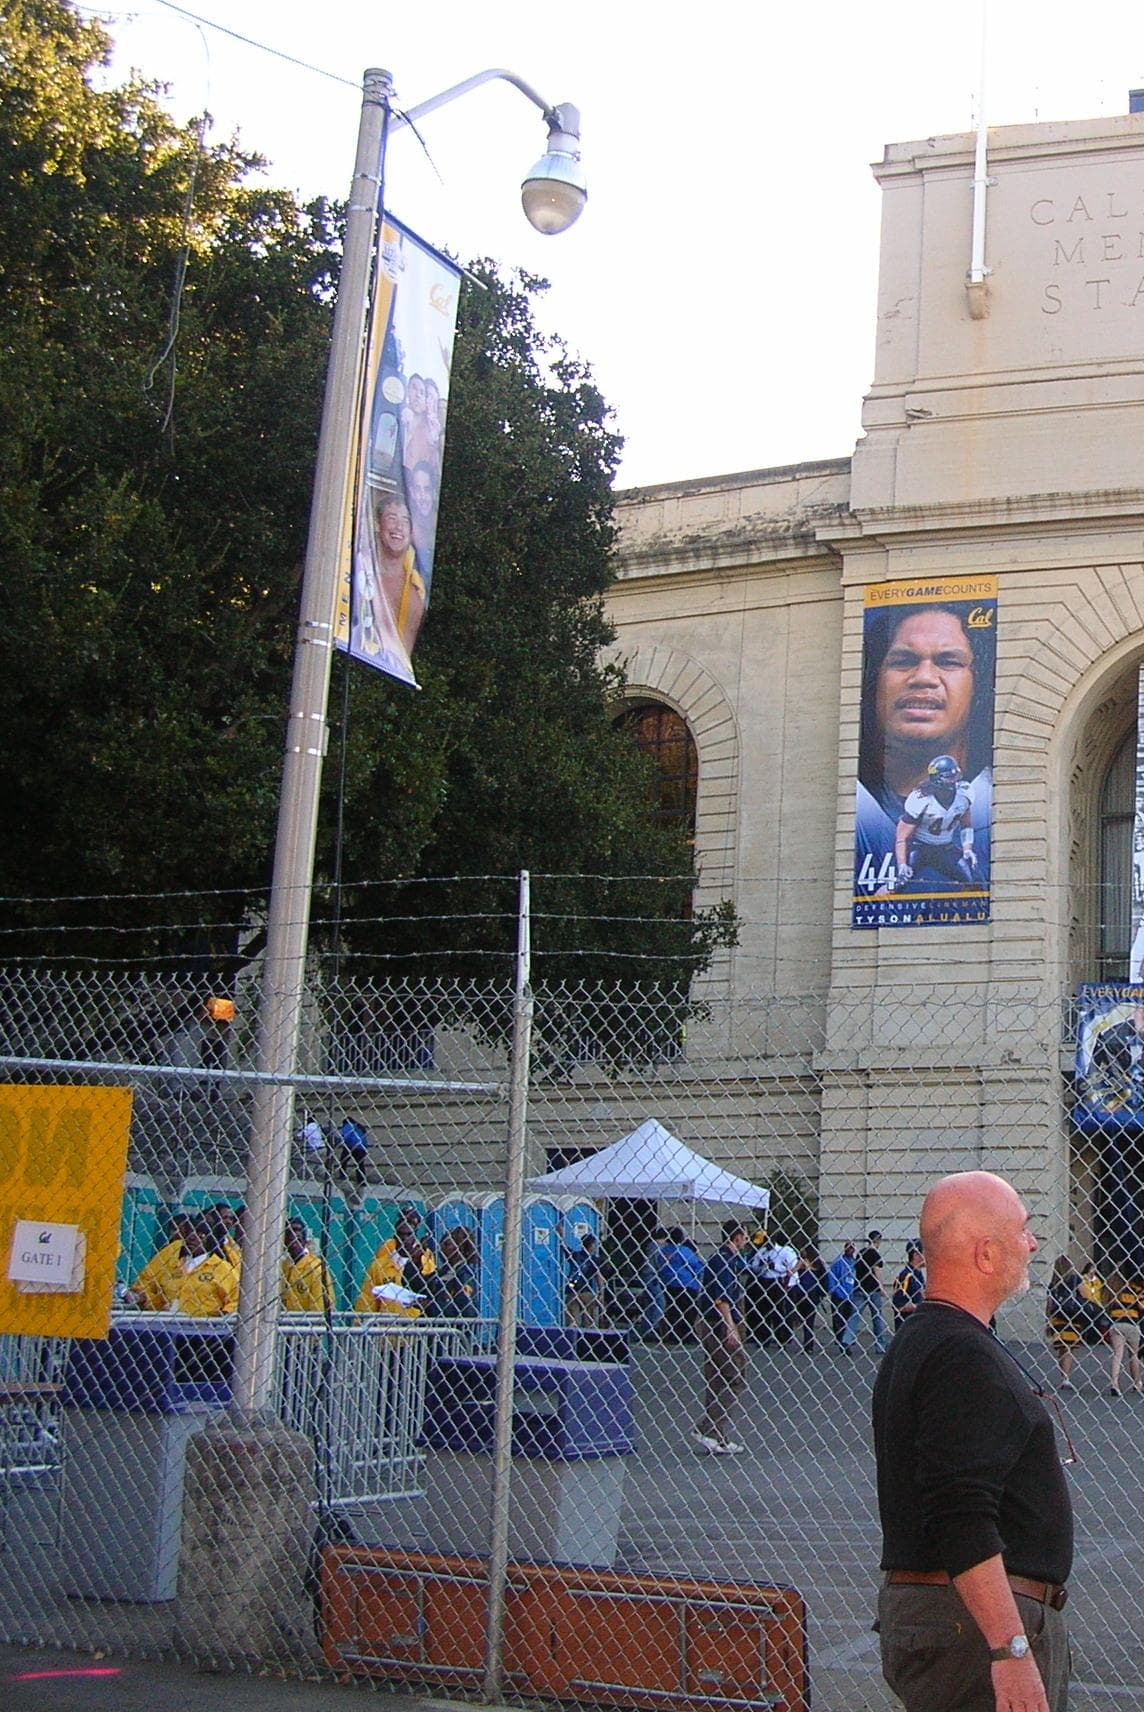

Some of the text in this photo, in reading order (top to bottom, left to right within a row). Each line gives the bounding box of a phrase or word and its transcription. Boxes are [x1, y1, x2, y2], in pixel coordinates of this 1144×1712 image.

[967, 607, 994, 628] Cal
[858, 852, 897, 891] 44
[856, 912, 986, 924] TYSON ALUALU
[22, 1251, 54, 1265] GATE
